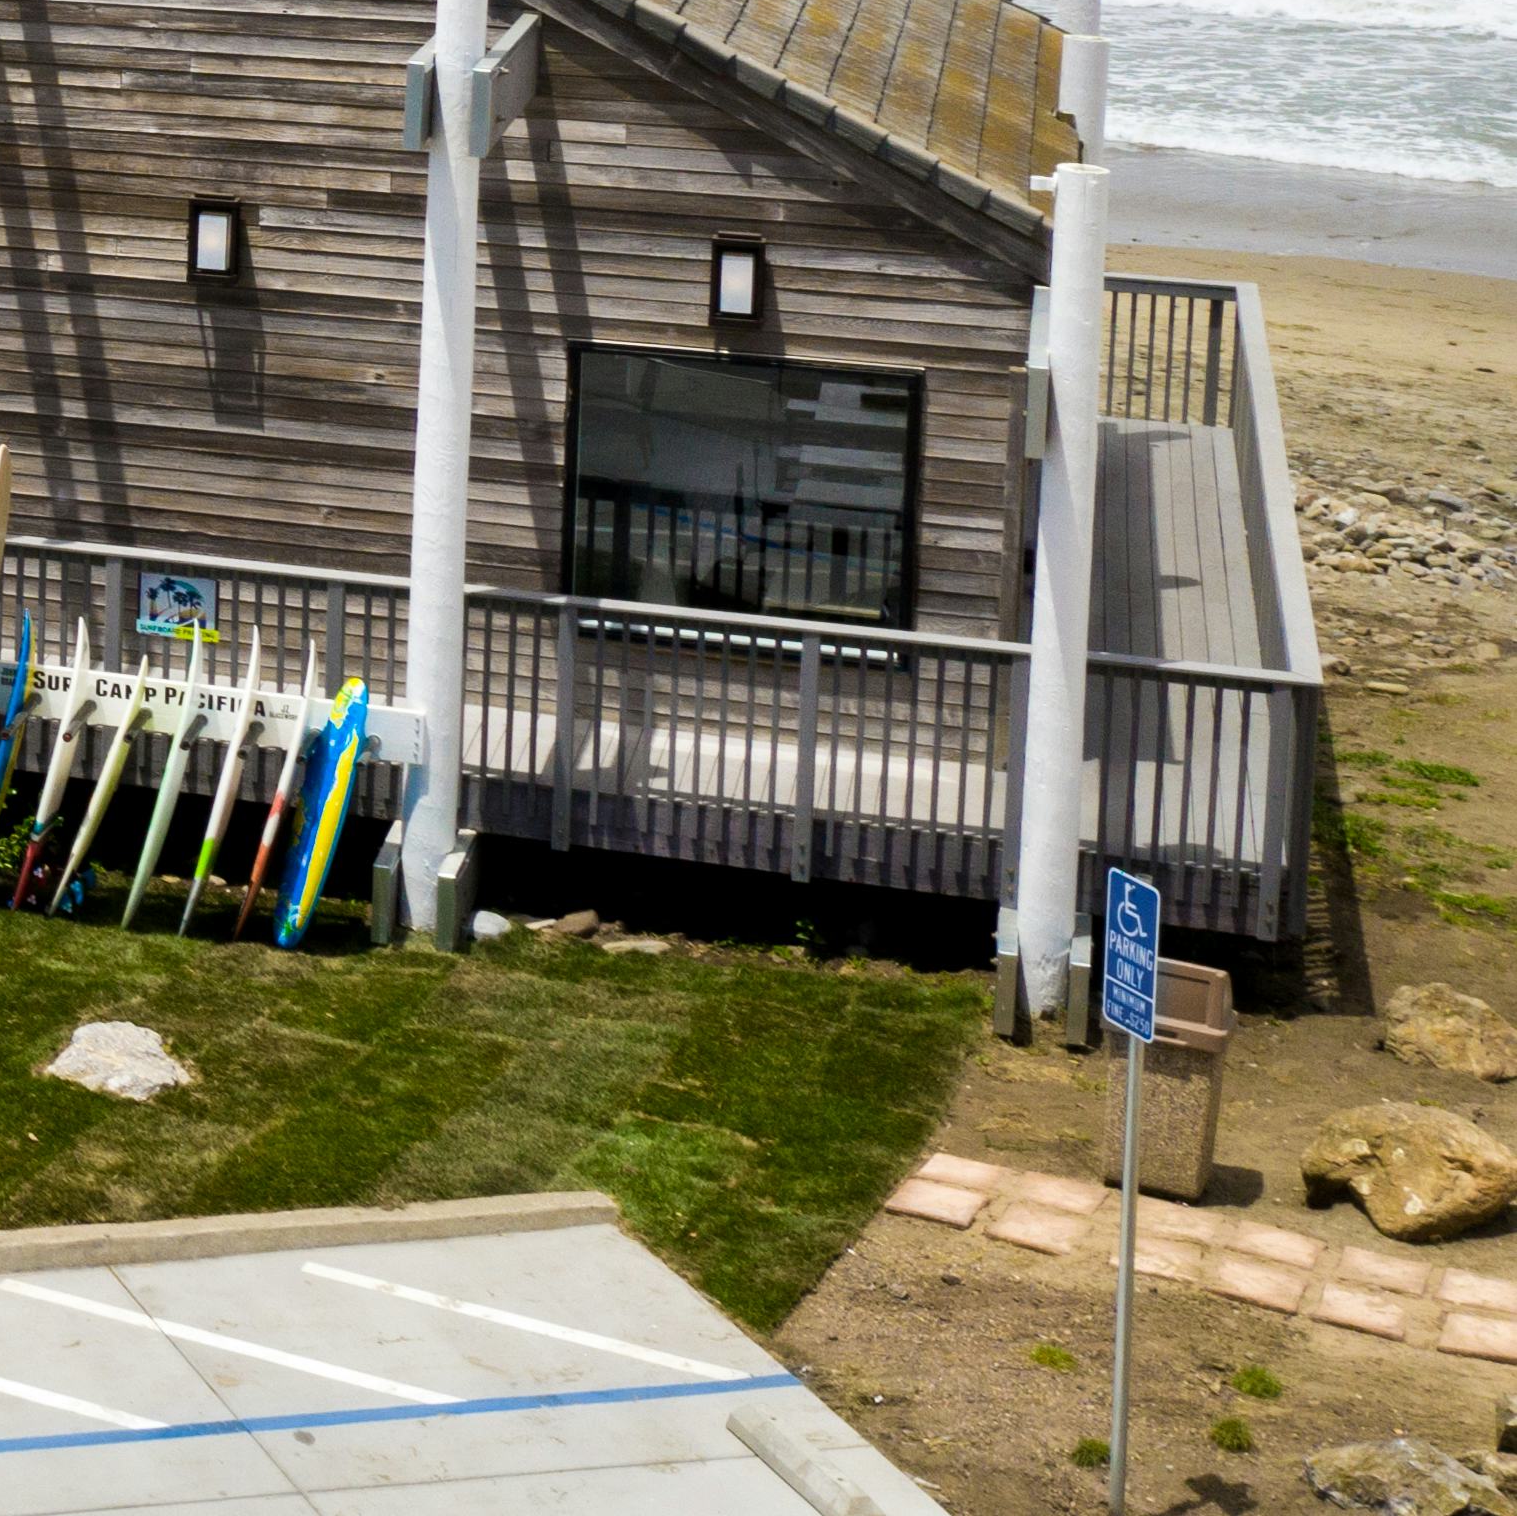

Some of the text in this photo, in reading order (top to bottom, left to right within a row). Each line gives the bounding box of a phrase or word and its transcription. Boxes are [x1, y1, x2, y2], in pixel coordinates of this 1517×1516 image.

[33, 670, 72, 692] SUR
[1109, 929, 1154, 972] PARKING
[1116, 959, 1144, 990] ONLY
[1107, 999, 1124, 1022] FINE
[1112, 986, 1146, 1014] MINIMUM
